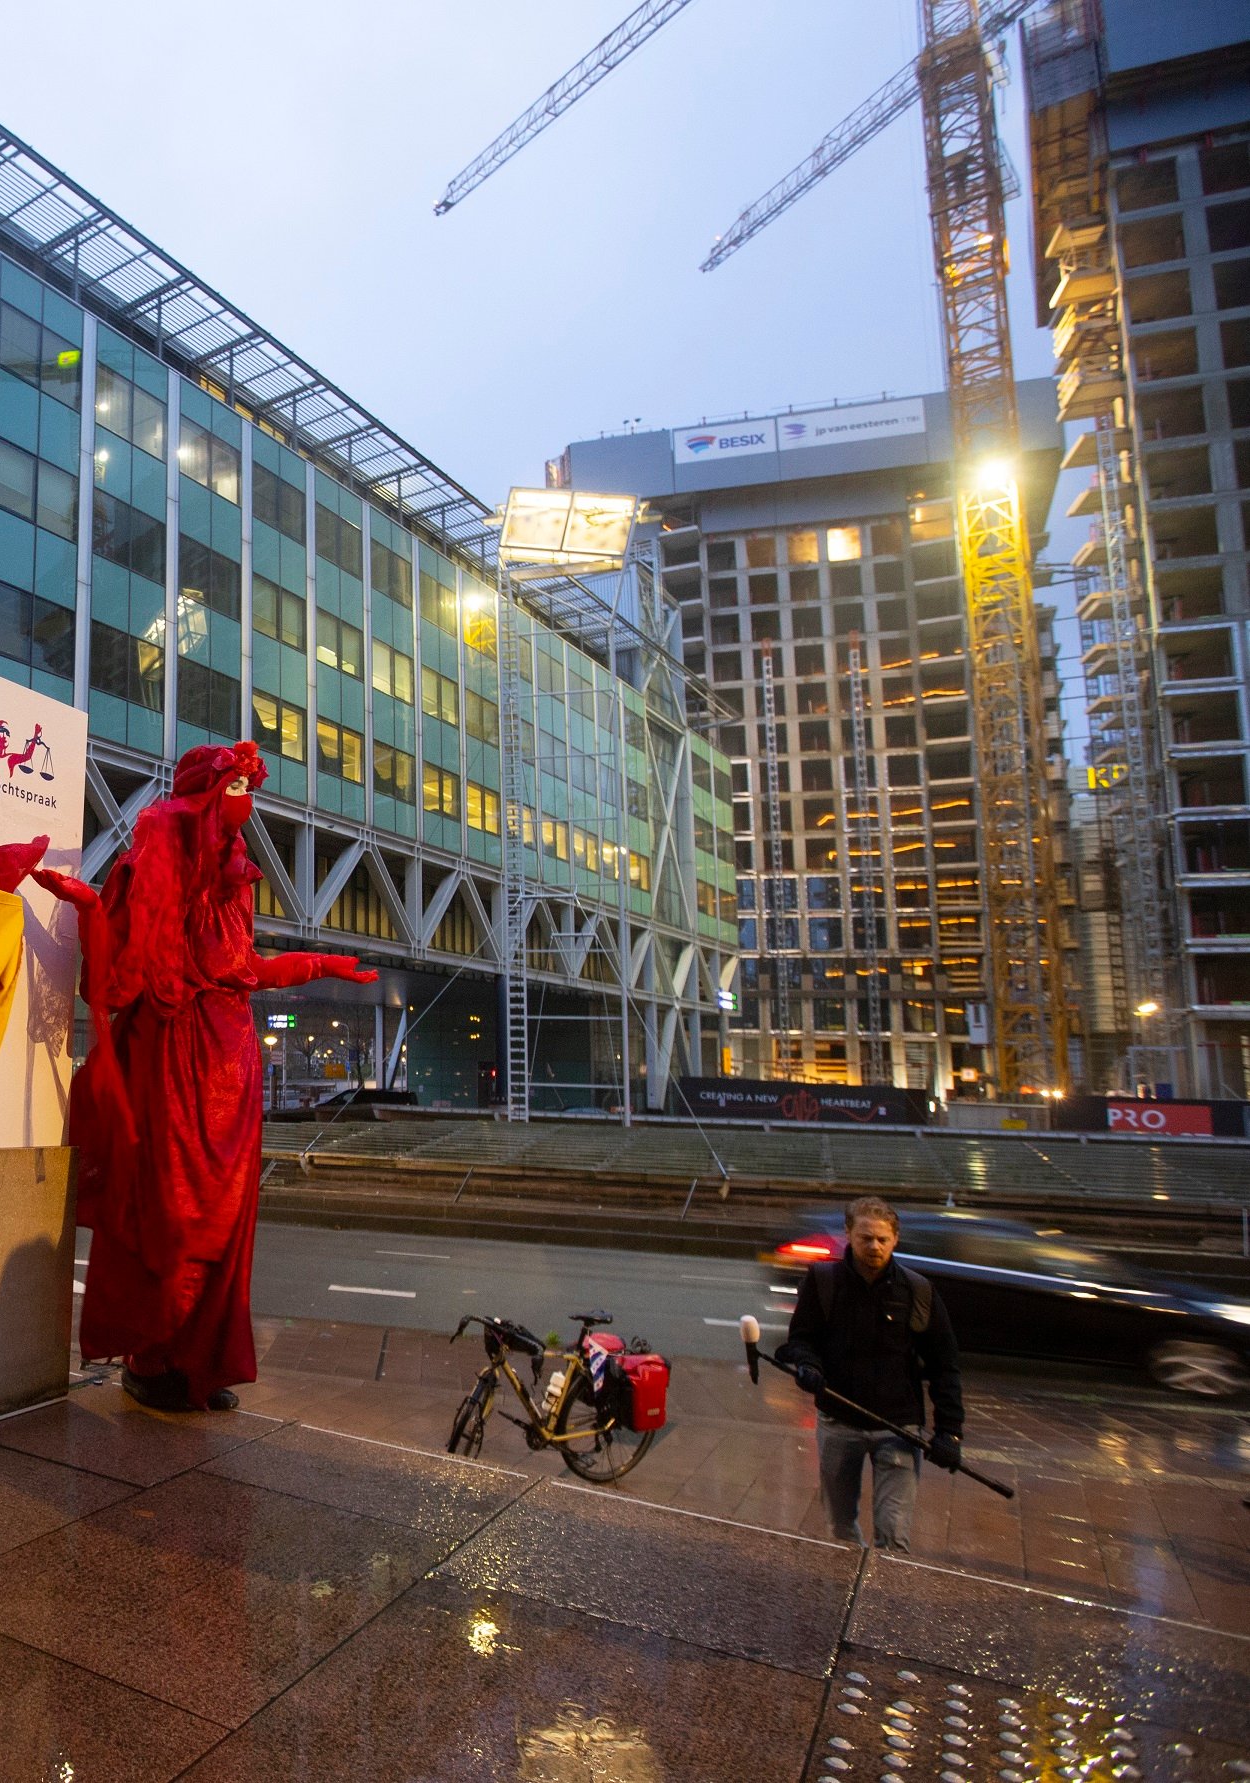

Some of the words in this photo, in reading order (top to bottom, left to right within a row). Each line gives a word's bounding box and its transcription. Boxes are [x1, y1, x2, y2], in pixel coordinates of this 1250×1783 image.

[815, 426, 826, 436] jp
[829, 424, 848, 432] van
[850, 418, 898, 430] eesteren
[719, 434, 765, 449] BESIX
[699, 1091, 744, 1102] CREATING
[746, 1094, 753, 1102] A
[755, 1094, 779, 1104] NEW
[820, 1098, 871, 1109] HEARTBEAT
[1107, 1108, 1166, 1128] PRO
